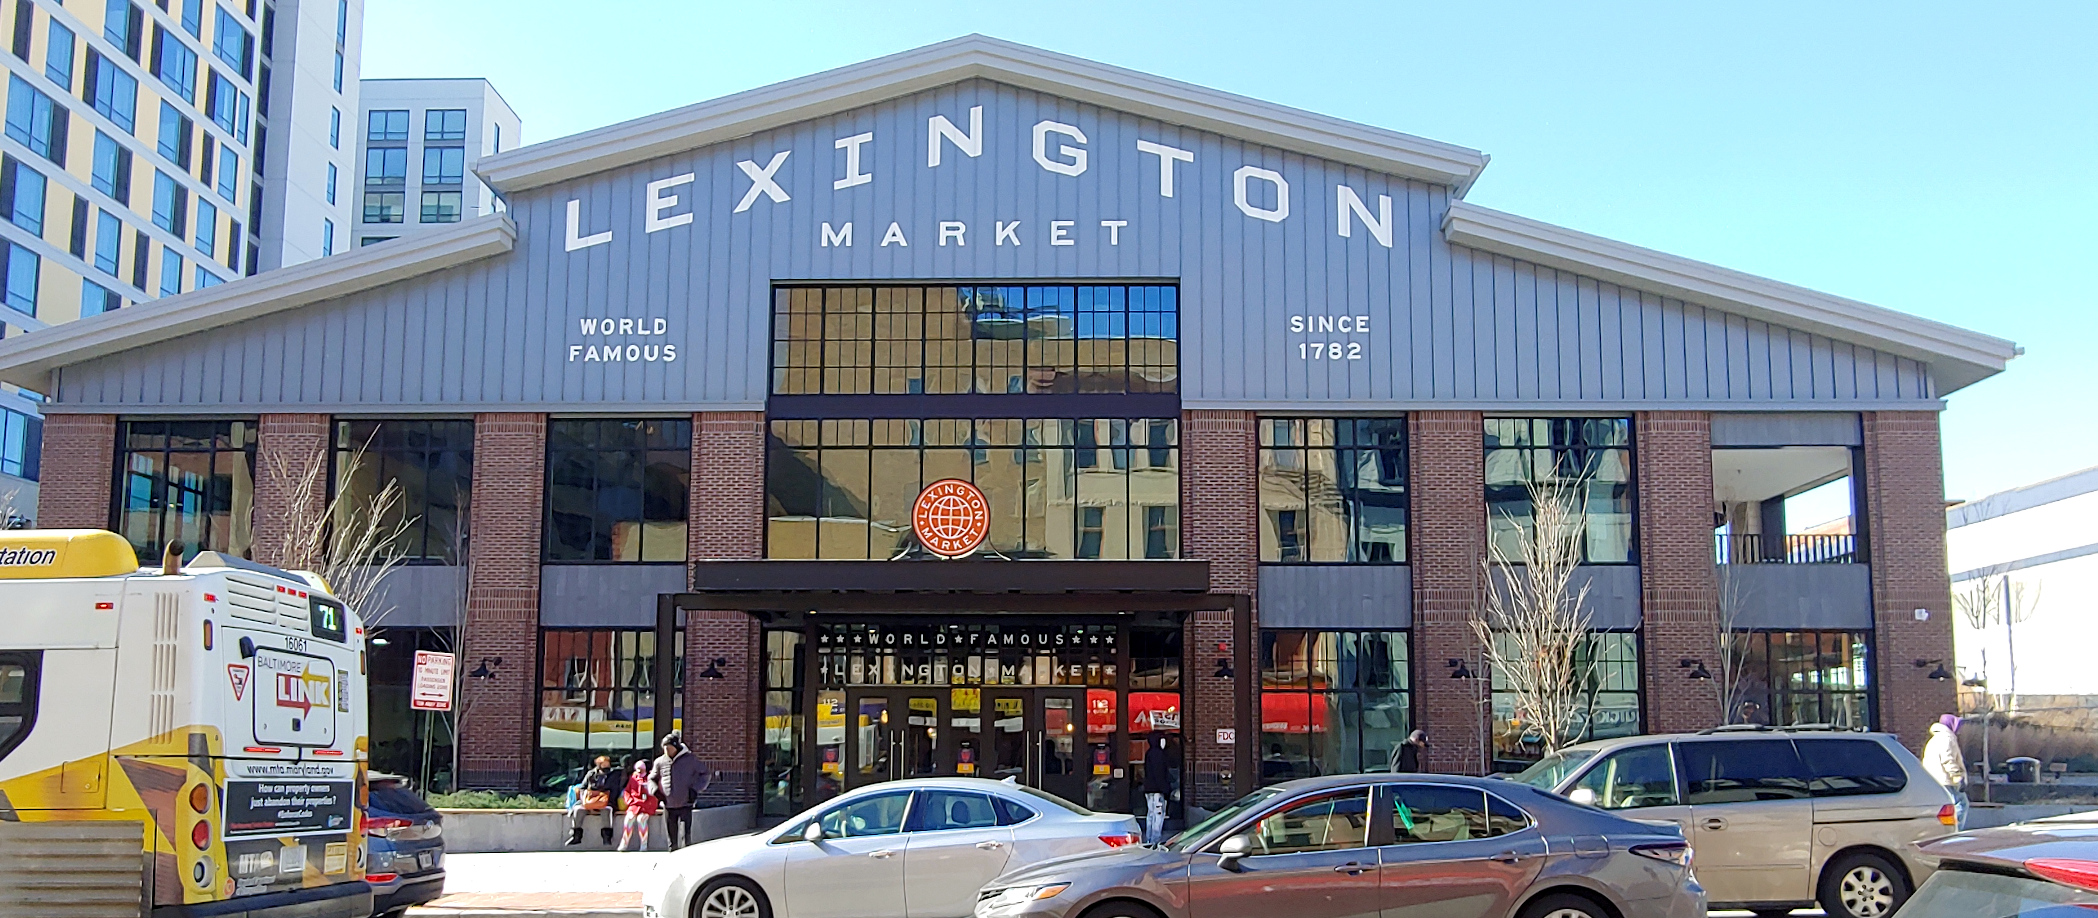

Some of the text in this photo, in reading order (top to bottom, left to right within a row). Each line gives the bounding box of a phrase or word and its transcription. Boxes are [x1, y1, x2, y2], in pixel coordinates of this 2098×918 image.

[565, 105, 1393, 252] LEXINGTON
[821, 221, 1128, 247] MARKET
[580, 318, 667, 336] WORLD
[1290, 315, 1370, 333] SINCE
[569, 344, 677, 363] FAMOUS
[1299, 343, 1362, 360] 1782
[919, 484, 984, 520] LEXINGTON
[921, 527, 979, 550] MARKET
[318, 605, 337, 631] 71
[284, 636, 308, 652] 16061
[868, 633, 1064, 646] WORLD FAMOUS
[257, 655, 302, 673] BALTIMORE
[1000, 664, 1100, 677] MAKET
[277, 674, 330, 705] LINK
[1217, 731, 1235, 741] FDC
